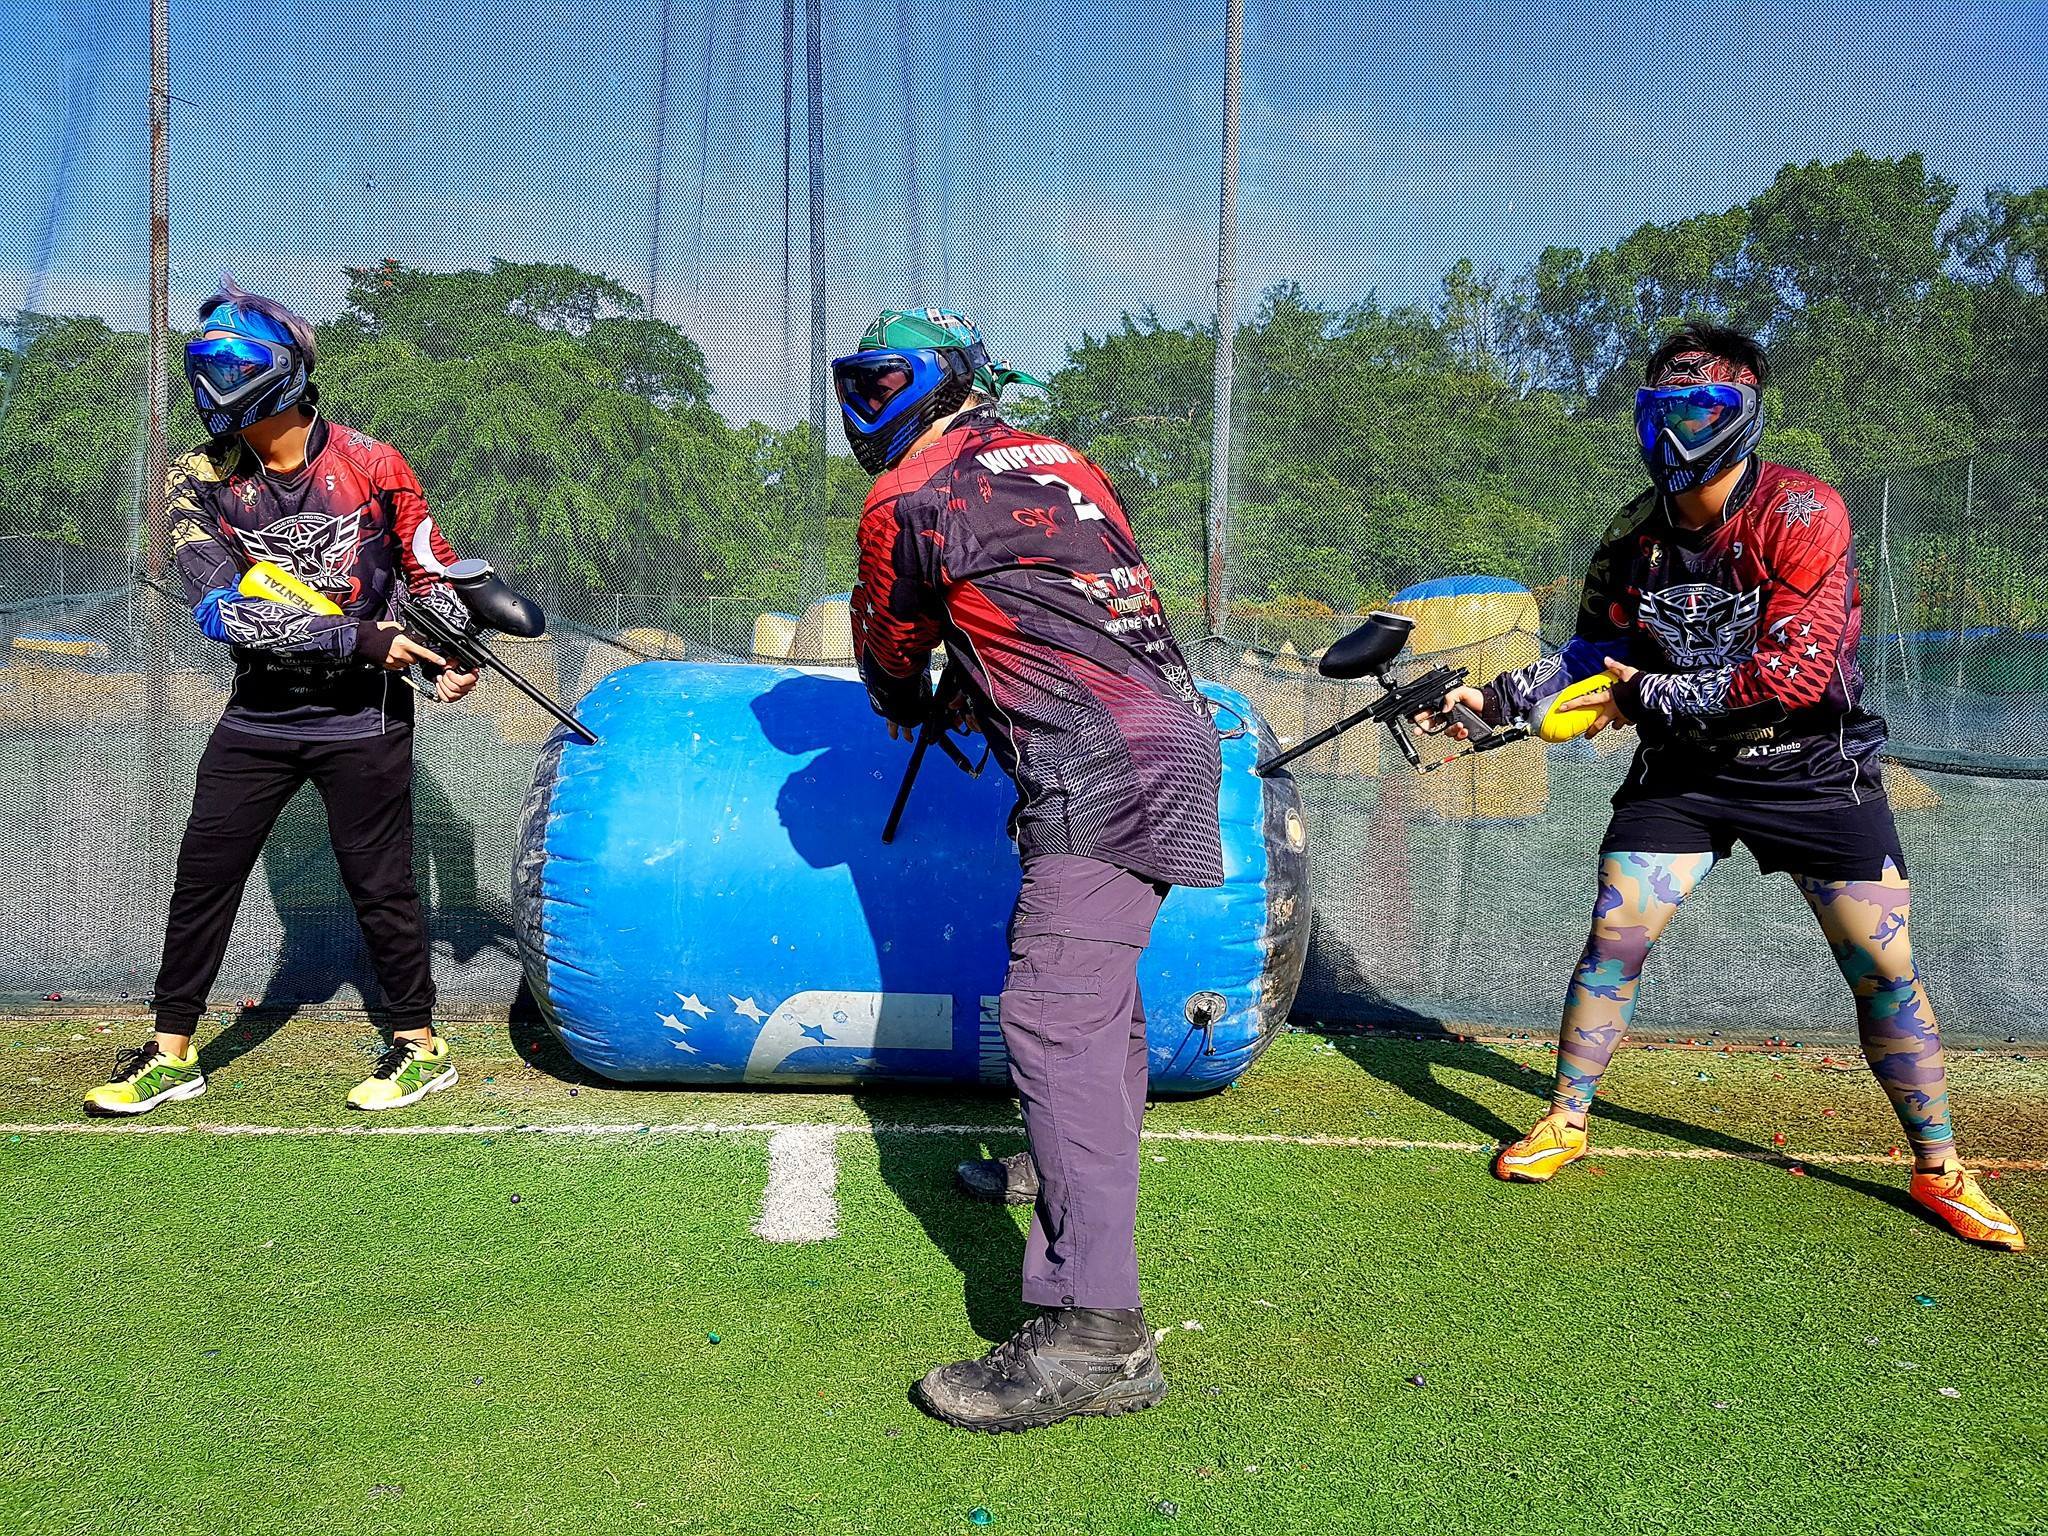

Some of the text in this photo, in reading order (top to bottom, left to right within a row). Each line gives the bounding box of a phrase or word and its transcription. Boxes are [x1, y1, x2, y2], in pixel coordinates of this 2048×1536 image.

[974, 443, 1077, 475] WIPEOUT
[264, 574, 315, 610] RENTAL
[1088, 1365, 1118, 1373] MERRELL
